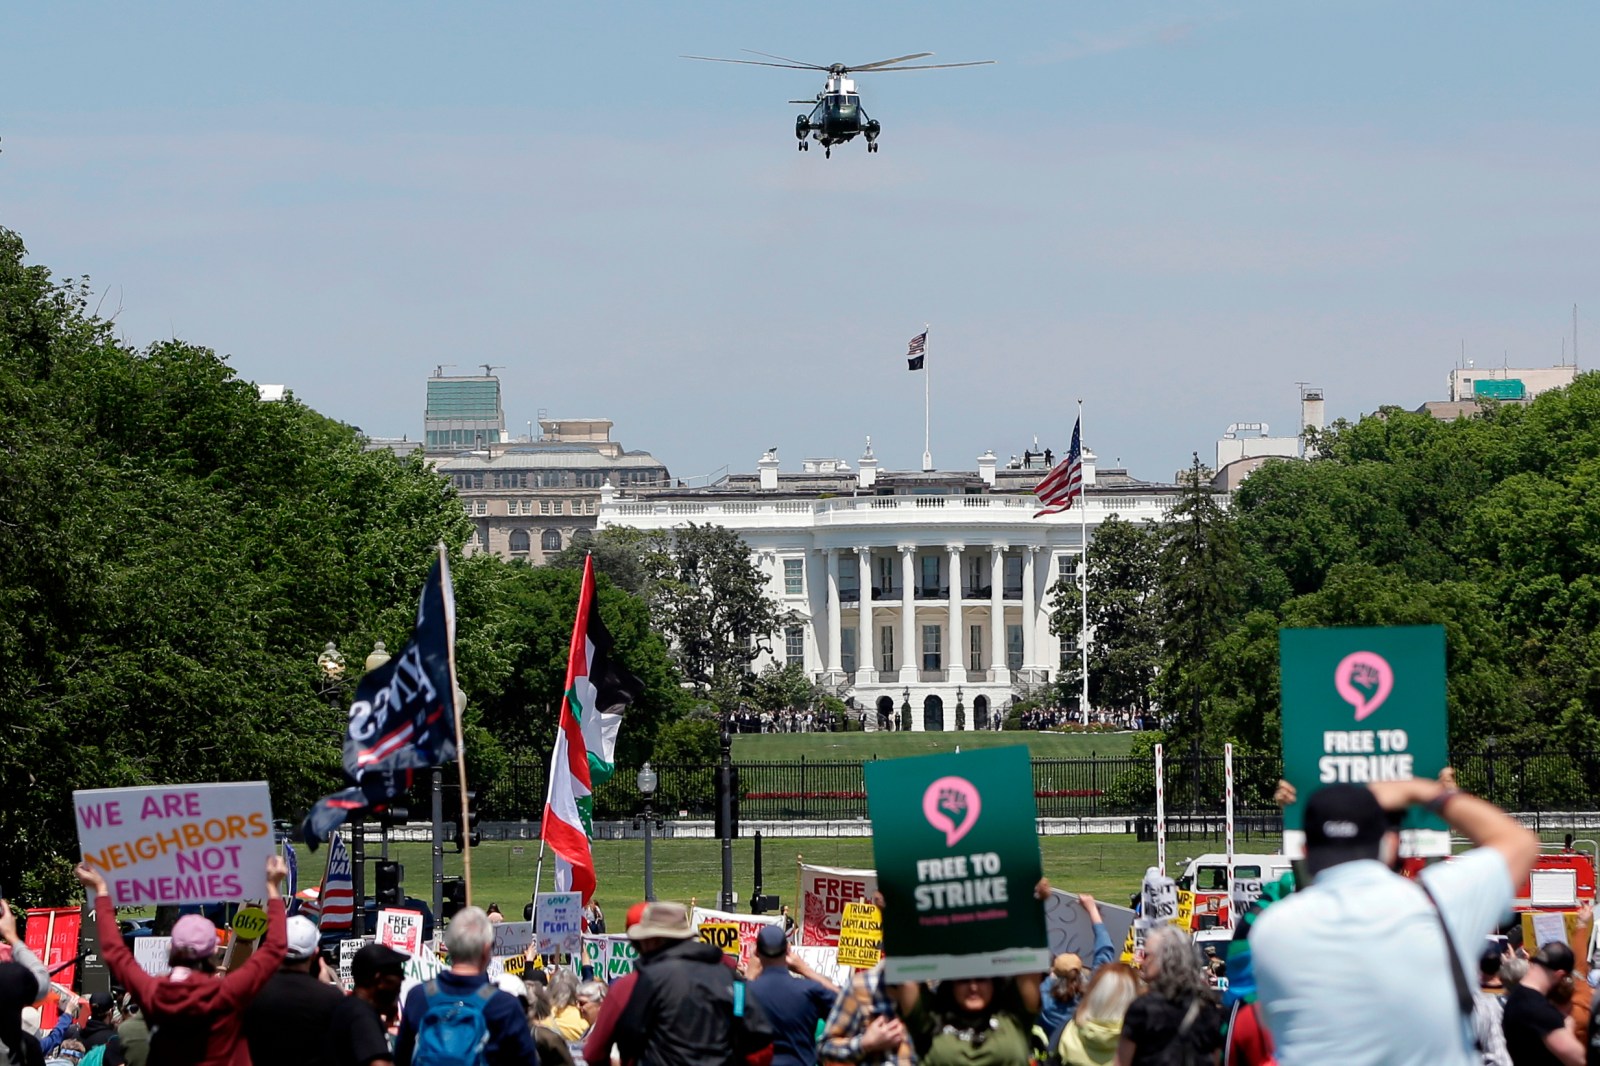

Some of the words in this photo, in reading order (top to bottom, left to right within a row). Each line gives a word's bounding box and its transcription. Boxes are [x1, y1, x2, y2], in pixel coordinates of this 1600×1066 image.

[1323, 730, 1375, 753] FREE
[1377, 729, 1408, 752] TO
[1319, 754, 1413, 783] STRIKE
[79, 801, 122, 829] WE
[141, 793, 201, 820] ARE
[83, 813, 269, 872] NEIGHBORS
[176, 846, 242, 874] NOT
[916, 856, 968, 882] FREE
[970, 852, 1000, 875] TO
[116, 874, 243, 903] ENEMIES
[814, 878, 865, 898] FREE
[914, 877, 1008, 911] STRIKE
[388, 914, 413, 926] FREE
[850, 904, 875, 914] TRUMP
[394, 925, 406, 935] DC
[700, 927, 738, 948] STOP
[138, 938, 168, 950] HOSPIT
[613, 942, 639, 959] NO
[845, 947, 857, 957] THE
[859, 949, 879, 960] CURE
